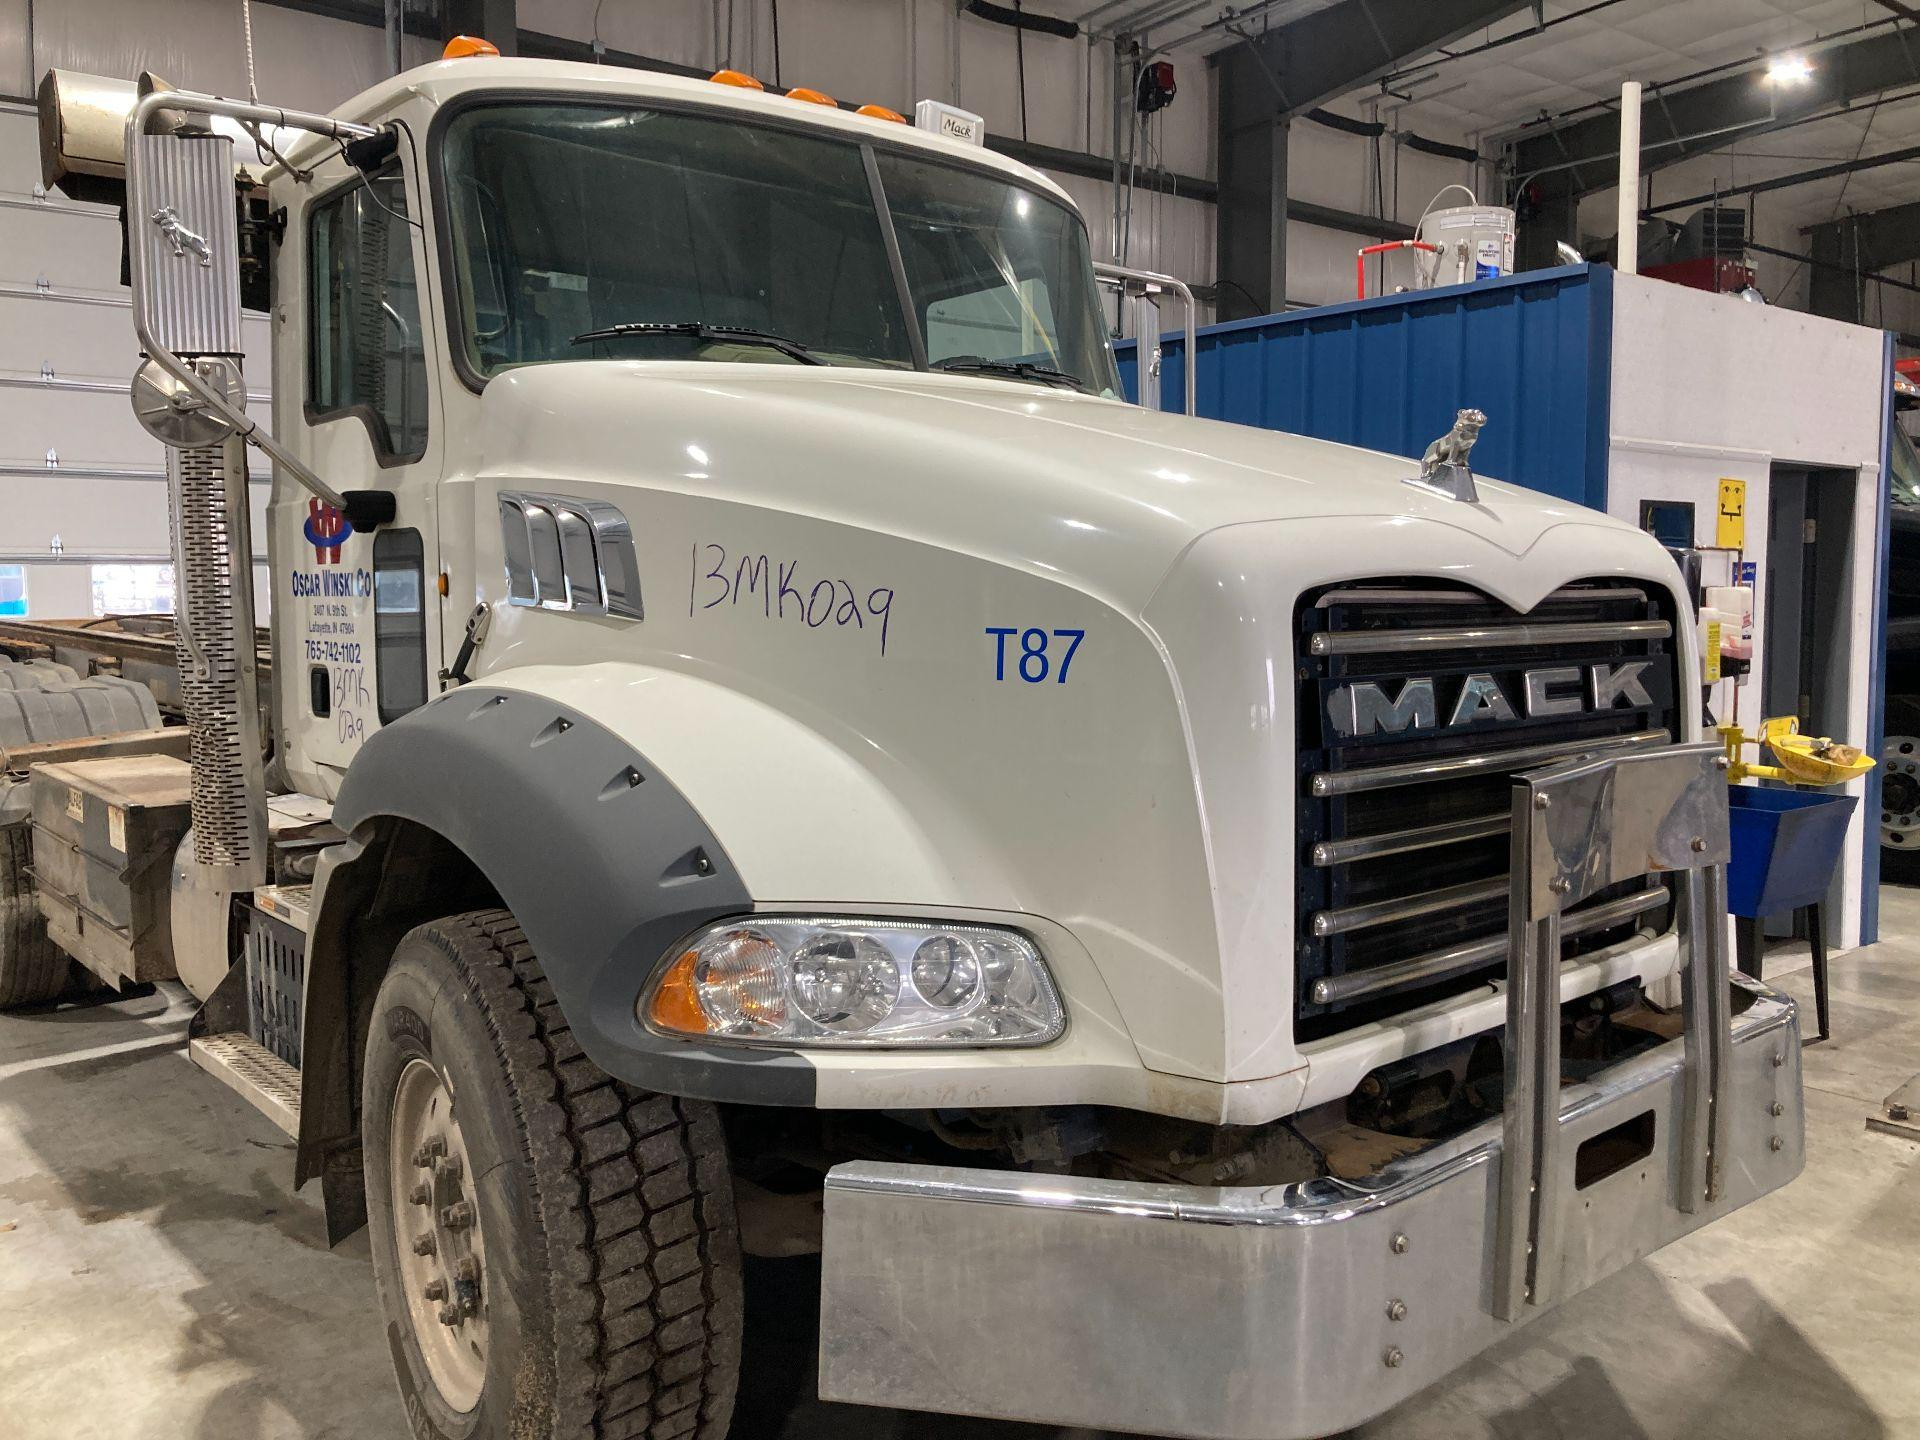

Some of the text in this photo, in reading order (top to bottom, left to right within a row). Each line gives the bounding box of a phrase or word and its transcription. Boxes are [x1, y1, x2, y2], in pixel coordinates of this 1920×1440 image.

[944, 118, 971, 137] Mack
[292, 567, 372, 597] OSCAR WINSKI CO
[304, 639, 361, 664] 765-742-1102
[985, 627, 1086, 684] T87
[1349, 660, 1654, 737] MACK
